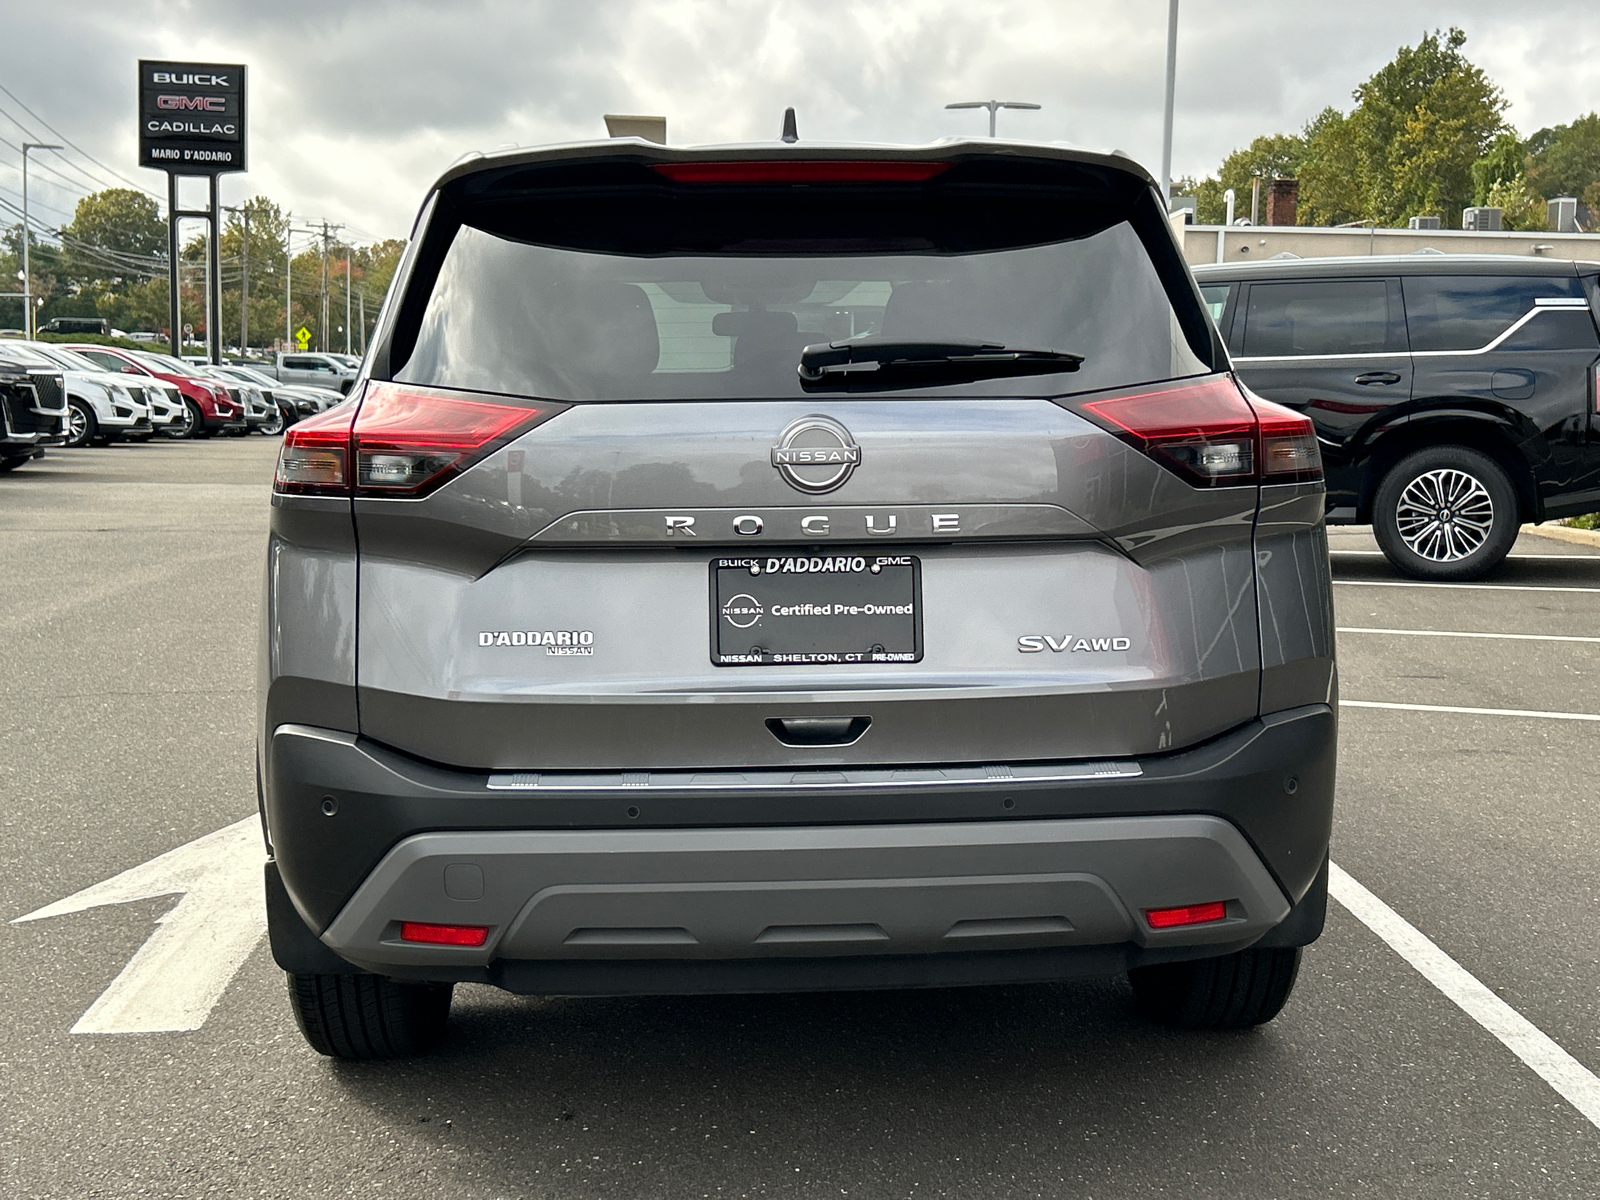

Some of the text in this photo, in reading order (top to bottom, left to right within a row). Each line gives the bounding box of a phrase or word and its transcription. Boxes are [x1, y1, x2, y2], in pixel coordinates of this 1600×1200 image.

[153, 73, 229, 86] BUICK
[157, 95, 225, 111] GMC
[148, 121, 235, 134] CADILLAC
[151, 149, 231, 161] MARIO D'ADDARIO
[775, 450, 858, 463] NISSAN
[664, 513, 961, 537] ROGUE
[719, 556, 911, 574] BUICK D'ADDARIO GMC
[722, 607, 764, 615] NISSAN
[771, 602, 914, 616] Certified Pre-Owned
[478, 630, 595, 647] D'ADDARIO
[546, 646, 593, 655] NISSAN
[720, 653, 915, 663] NISSAN SHELTON, CT PRE-OWNED
